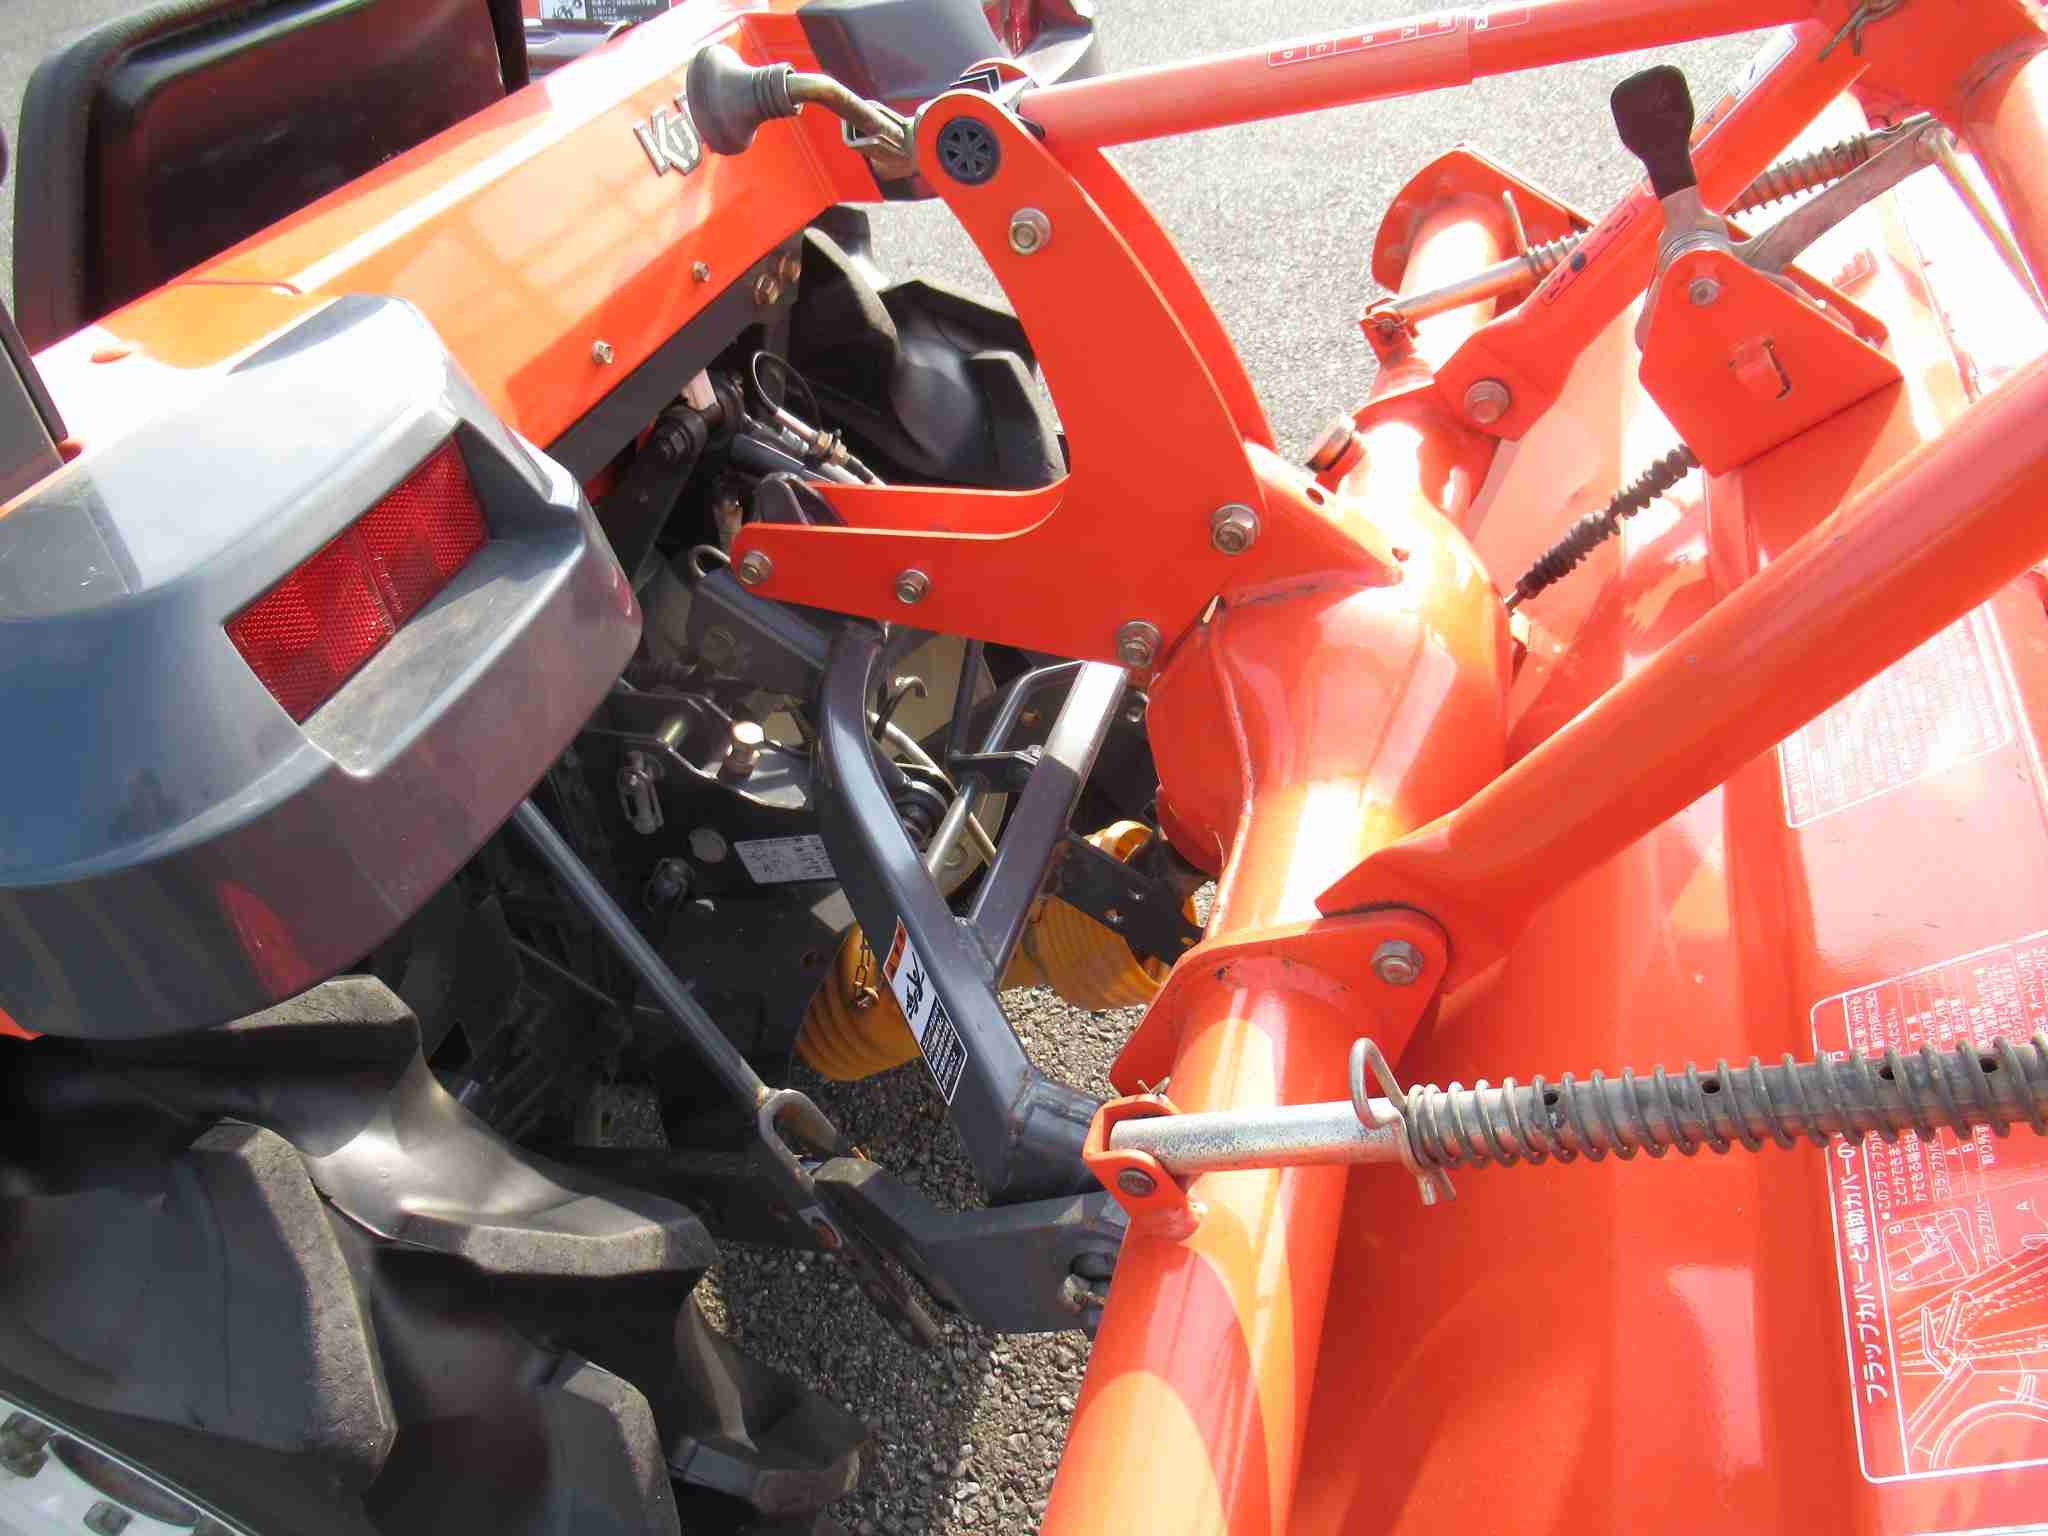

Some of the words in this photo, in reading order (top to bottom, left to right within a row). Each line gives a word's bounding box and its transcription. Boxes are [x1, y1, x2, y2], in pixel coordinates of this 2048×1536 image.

[633, 91, 704, 177] Ku
[1836, 1131, 1889, 1405] フラップカバーと補助カバーの
